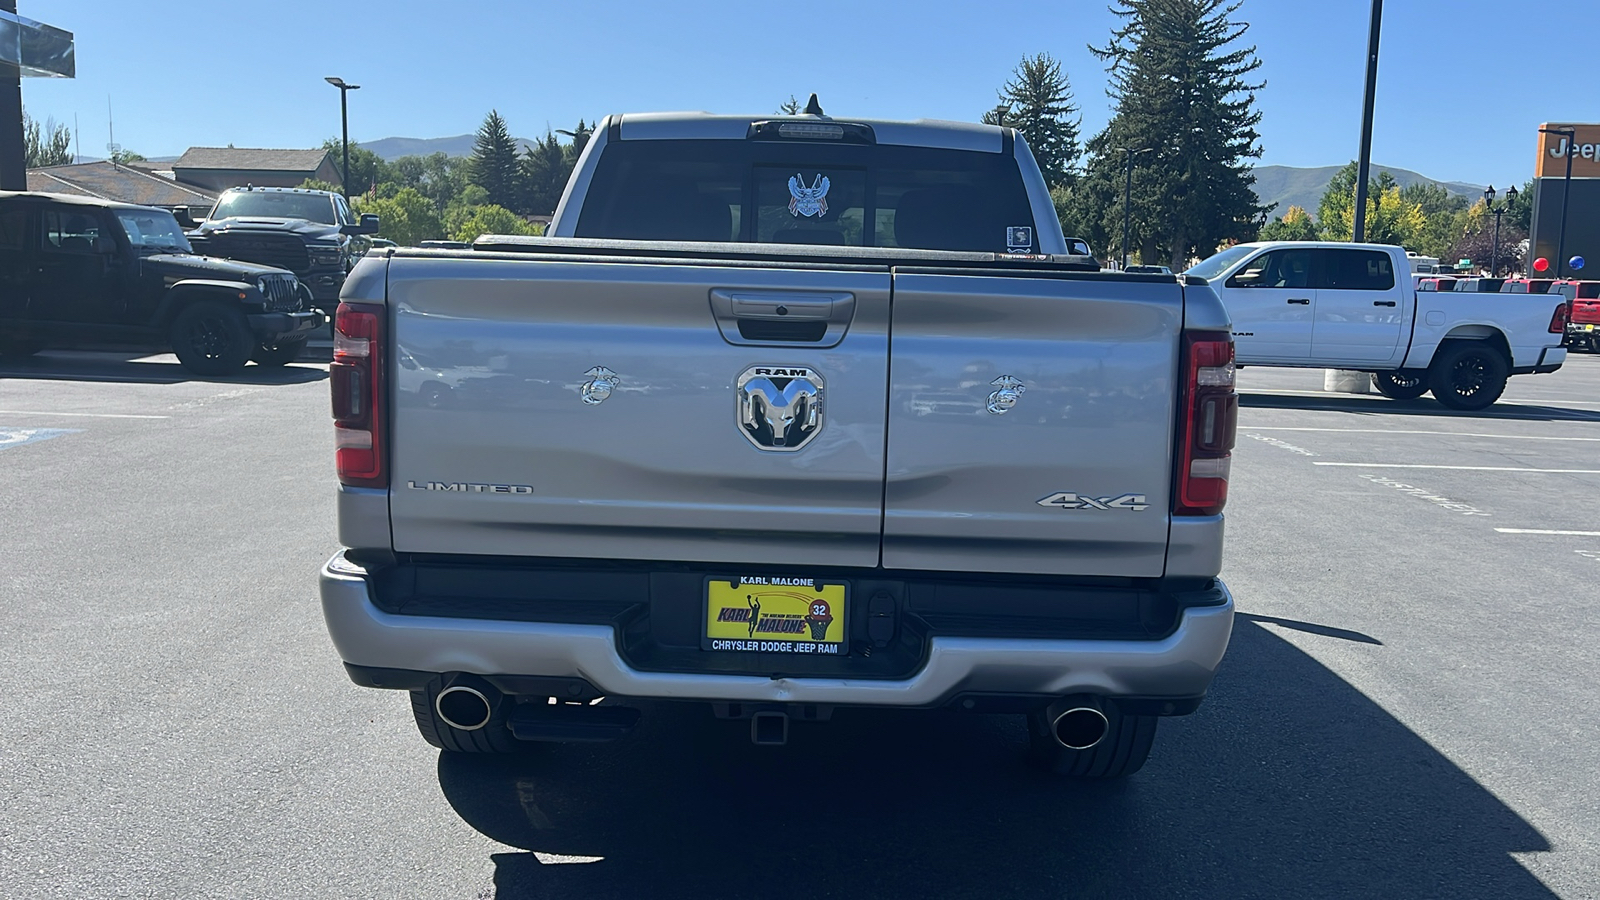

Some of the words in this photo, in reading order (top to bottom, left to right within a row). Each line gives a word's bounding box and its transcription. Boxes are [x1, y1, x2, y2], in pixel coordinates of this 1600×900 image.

[755, 368, 807, 376] RAM
[407, 480, 533, 494] LIMITED
[740, 576, 768, 585] KARL
[772, 577, 814, 587] MALONE
[717, 607, 751, 623] KARL
[813, 604, 826, 616] 32
[756, 618, 807, 634] MALONE
[712, 640, 758, 651] CHRYSLER
[761, 641, 791, 652] DODGE
[793, 643, 815, 653] JEEP
[818, 643, 838, 653] RAM
